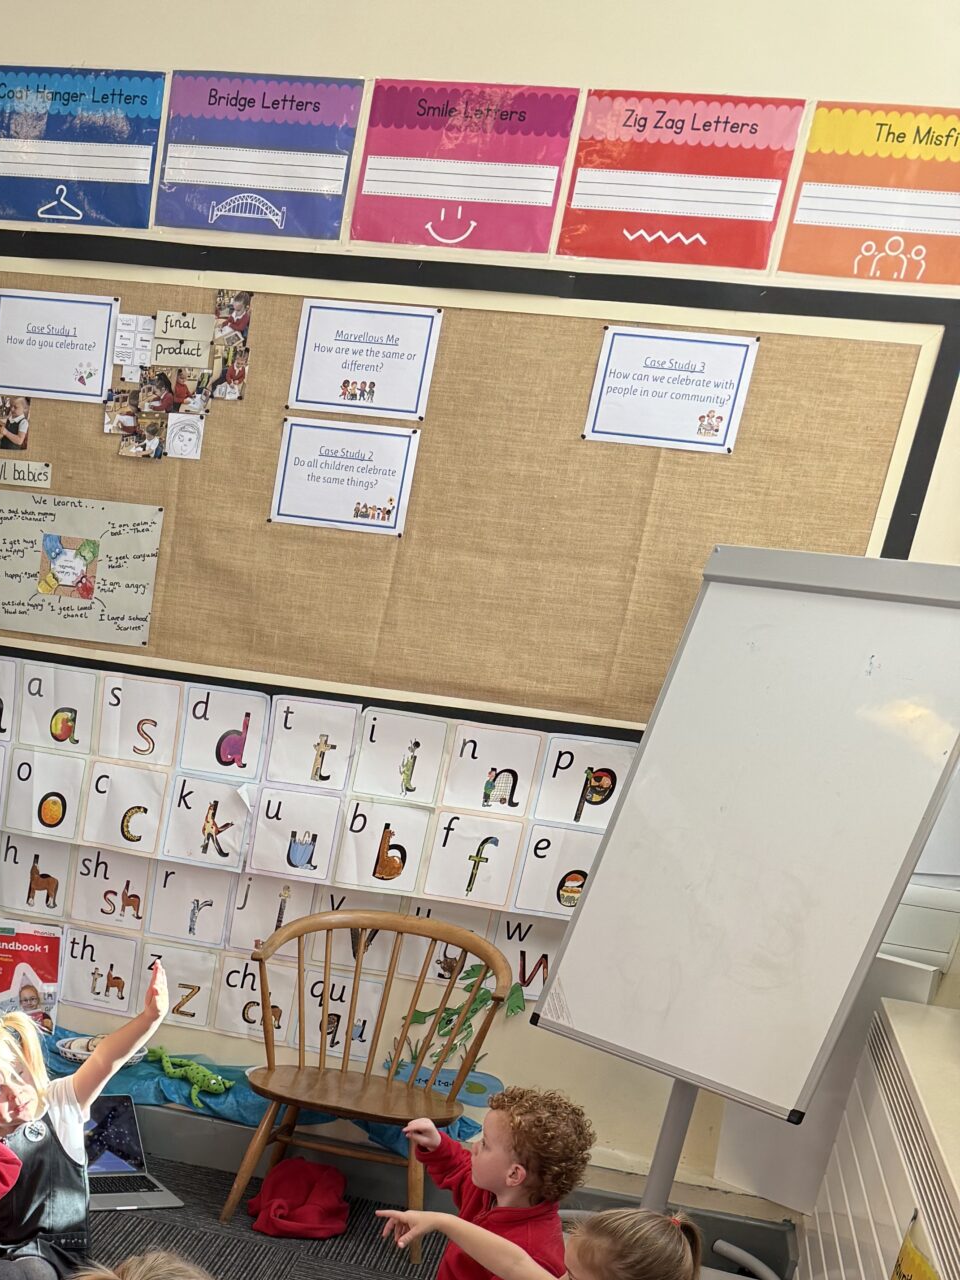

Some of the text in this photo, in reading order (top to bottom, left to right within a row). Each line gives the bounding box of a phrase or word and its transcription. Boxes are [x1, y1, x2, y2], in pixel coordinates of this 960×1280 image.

[37, 89, 85, 106] Hanger
[91, 88, 147, 106] Letters
[208, 88, 320, 112] Bridge Letters
[417, 99, 526, 122] Smile Letters
[622, 109, 759, 135] Zig Zag Letters
[875, 122, 906, 143] The
[26, 323, 77, 336] Case Study 1
[162, 315, 197, 334] final
[7, 336, 96, 351] How do you celebrate?
[335, 330, 399, 345] Marvellous Me
[156, 343, 202, 360] product
[314, 343, 333, 353] How
[352, 348, 363, 356] we
[366, 347, 380, 357] the
[382, 351, 405, 360] same
[407, 353, 416, 361] or
[341, 359, 384, 372] different?
[644, 357, 706, 373] Case Study 3
[609, 369, 630, 379] How
[632, 373, 649, 381] can
[667, 375, 711, 387] celebrate
[714, 380, 734, 390] with
[606, 385, 731, 407] people in our community?
[319, 446, 374, 460] Case Study 2
[13, 461, 48, 483] babies
[294, 457, 396, 477] Do all children celebrate
[307, 472, 378, 490] the same things?
[32, 495, 47, 505] We
[28, 677, 43, 698] a
[109, 687, 122, 706] s
[192, 692, 211, 720] d
[283, 706, 294, 730] t
[369, 717, 377, 743] i
[460, 738, 478, 760] n
[17, 762, 31, 781] o
[552, 750, 574, 778] p
[95, 775, 109, 794] c
[177, 780, 195, 809] k
[266, 799, 282, 821] u
[349, 803, 367, 833] b
[442, 816, 460, 847] f
[4, 836, 19, 864] h
[533, 838, 551, 859] e
[80, 851, 109, 880] sh
[162, 869, 176, 889] r
[237, 878, 252, 910] j
[506, 920, 534, 942] w
[70, 935, 96, 962] th
[226, 963, 257, 992] ch
[310, 979, 346, 1009] qu
